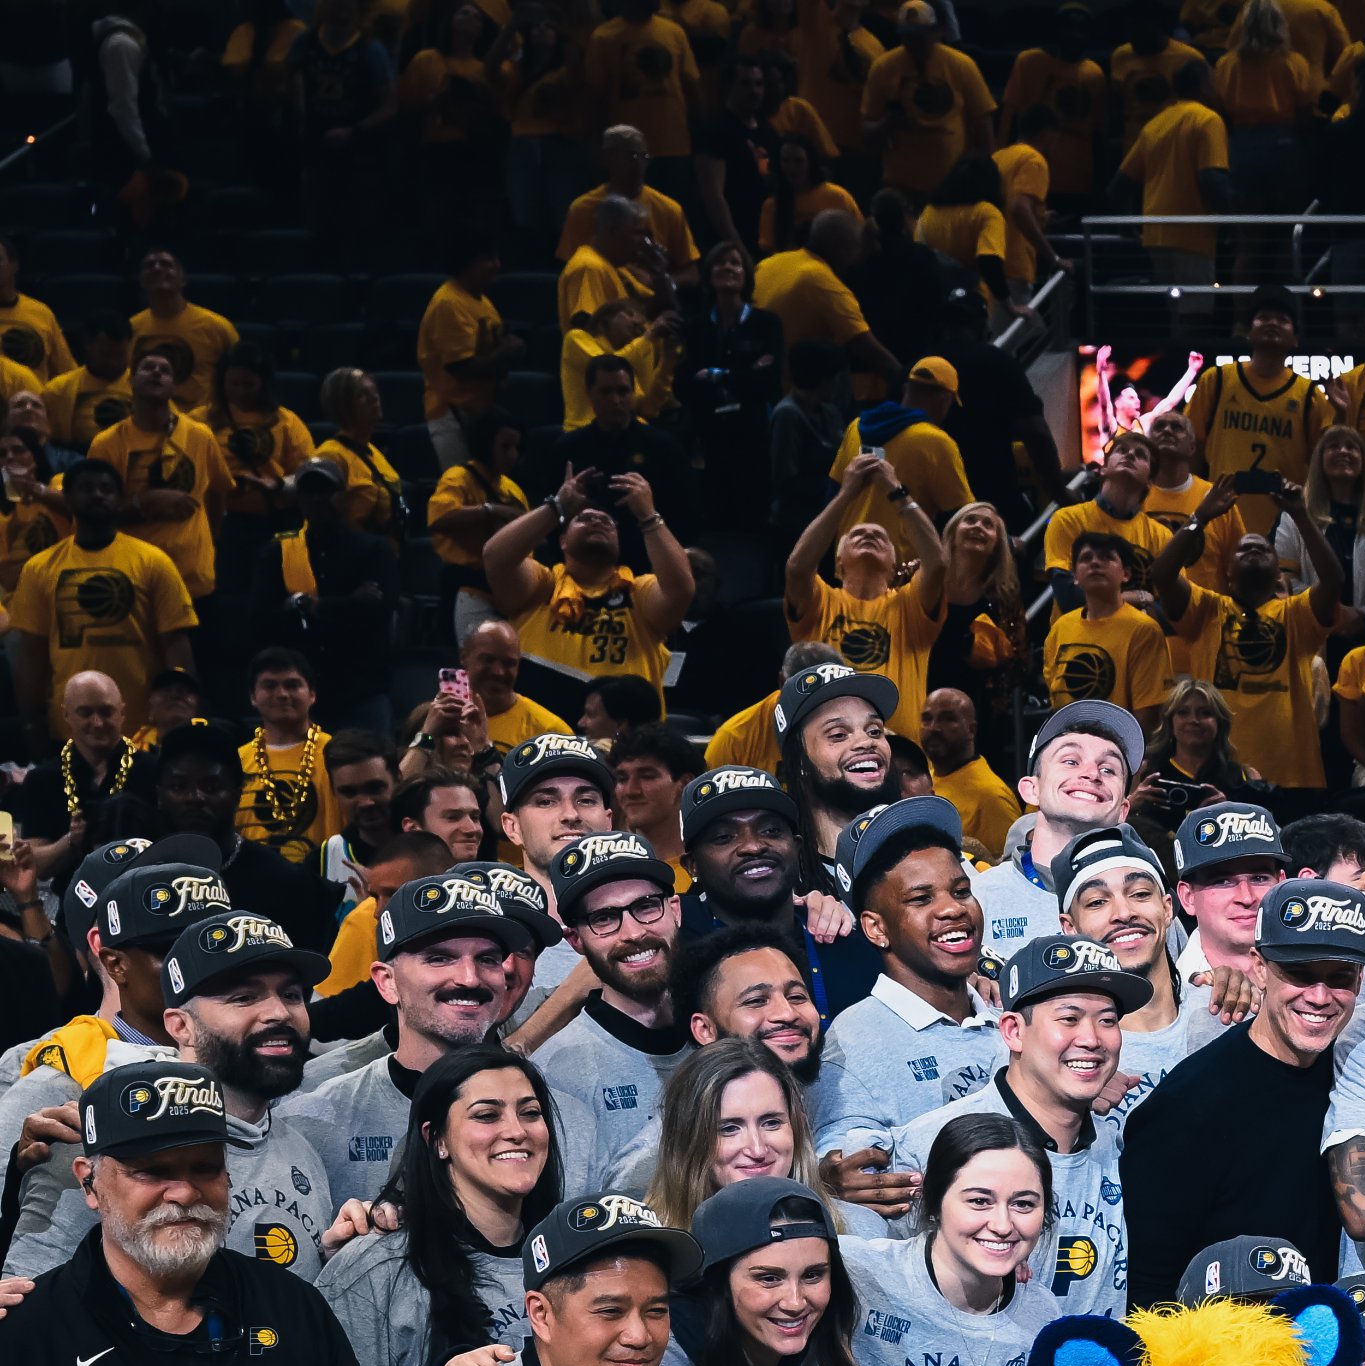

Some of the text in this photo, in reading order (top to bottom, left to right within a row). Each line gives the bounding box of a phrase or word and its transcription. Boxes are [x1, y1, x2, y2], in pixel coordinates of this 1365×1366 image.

[1223, 409, 1293, 439] INDIANA
[590, 636, 628, 665] 33
[530, 733, 597, 766] Finals
[1212, 812, 1274, 847] Finals
[578, 833, 649, 875] Finals
[169, 876, 231, 917] Finals
[488, 868, 544, 910] Finals
[1297, 896, 1365, 934] Finals
[147, 1077, 223, 1120] Finals
